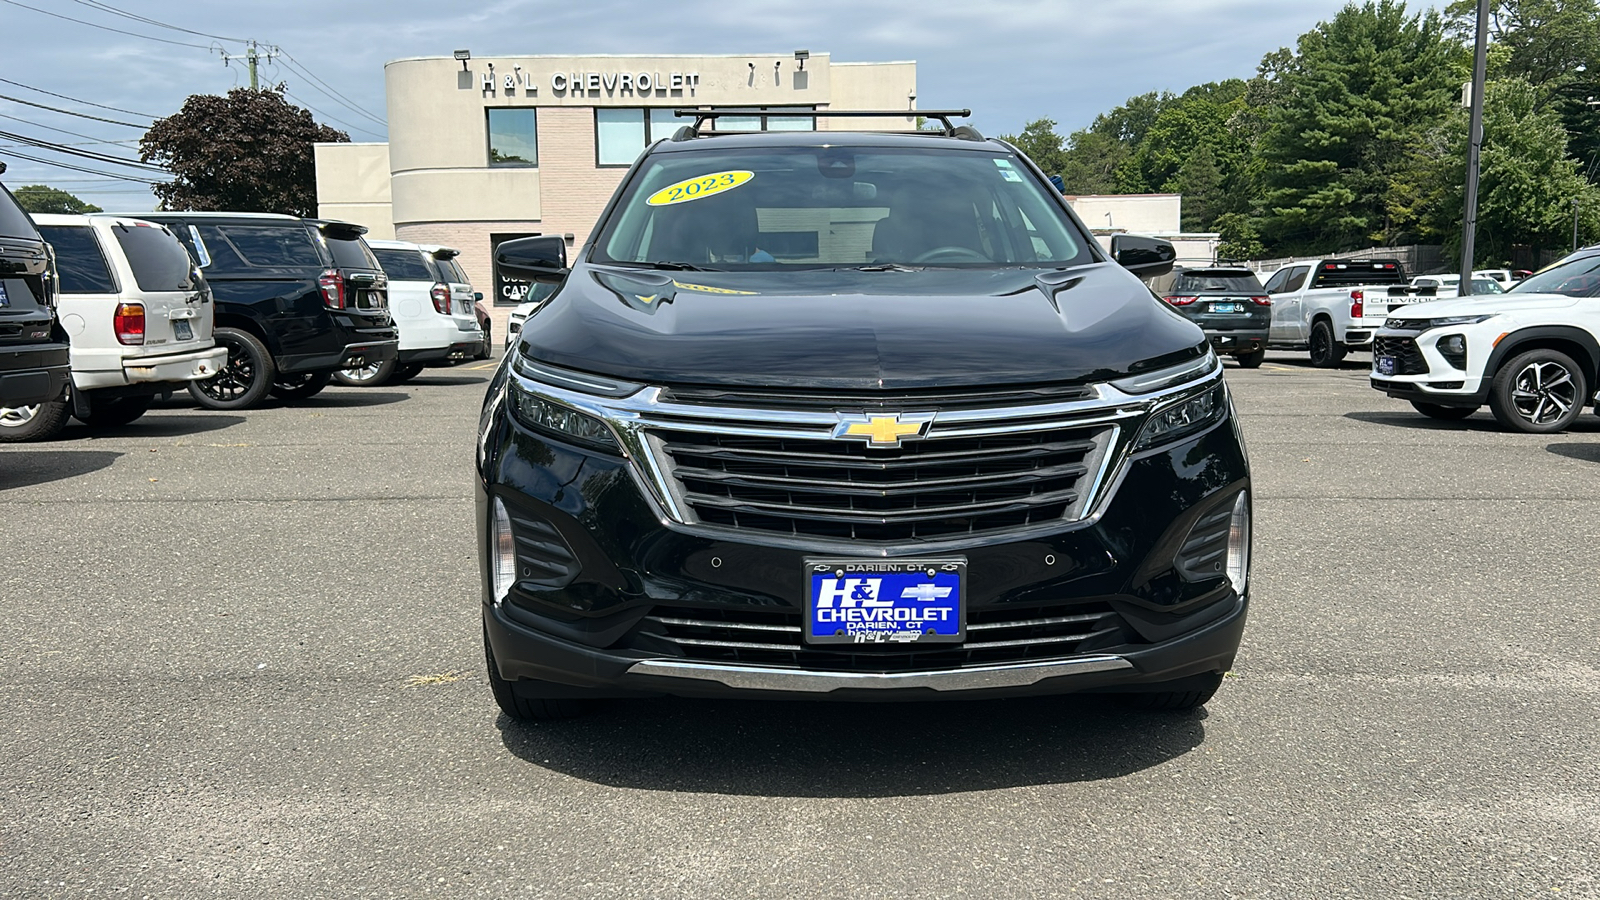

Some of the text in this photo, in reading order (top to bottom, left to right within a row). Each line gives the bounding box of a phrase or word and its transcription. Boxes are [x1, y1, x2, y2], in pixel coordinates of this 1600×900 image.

[551, 72, 700, 90] CHEVROLET
[668, 174, 735, 202] 2023
[816, 578, 894, 608] H&L
[817, 607, 953, 622] CHEVROLET
[905, 621, 924, 629] CT
